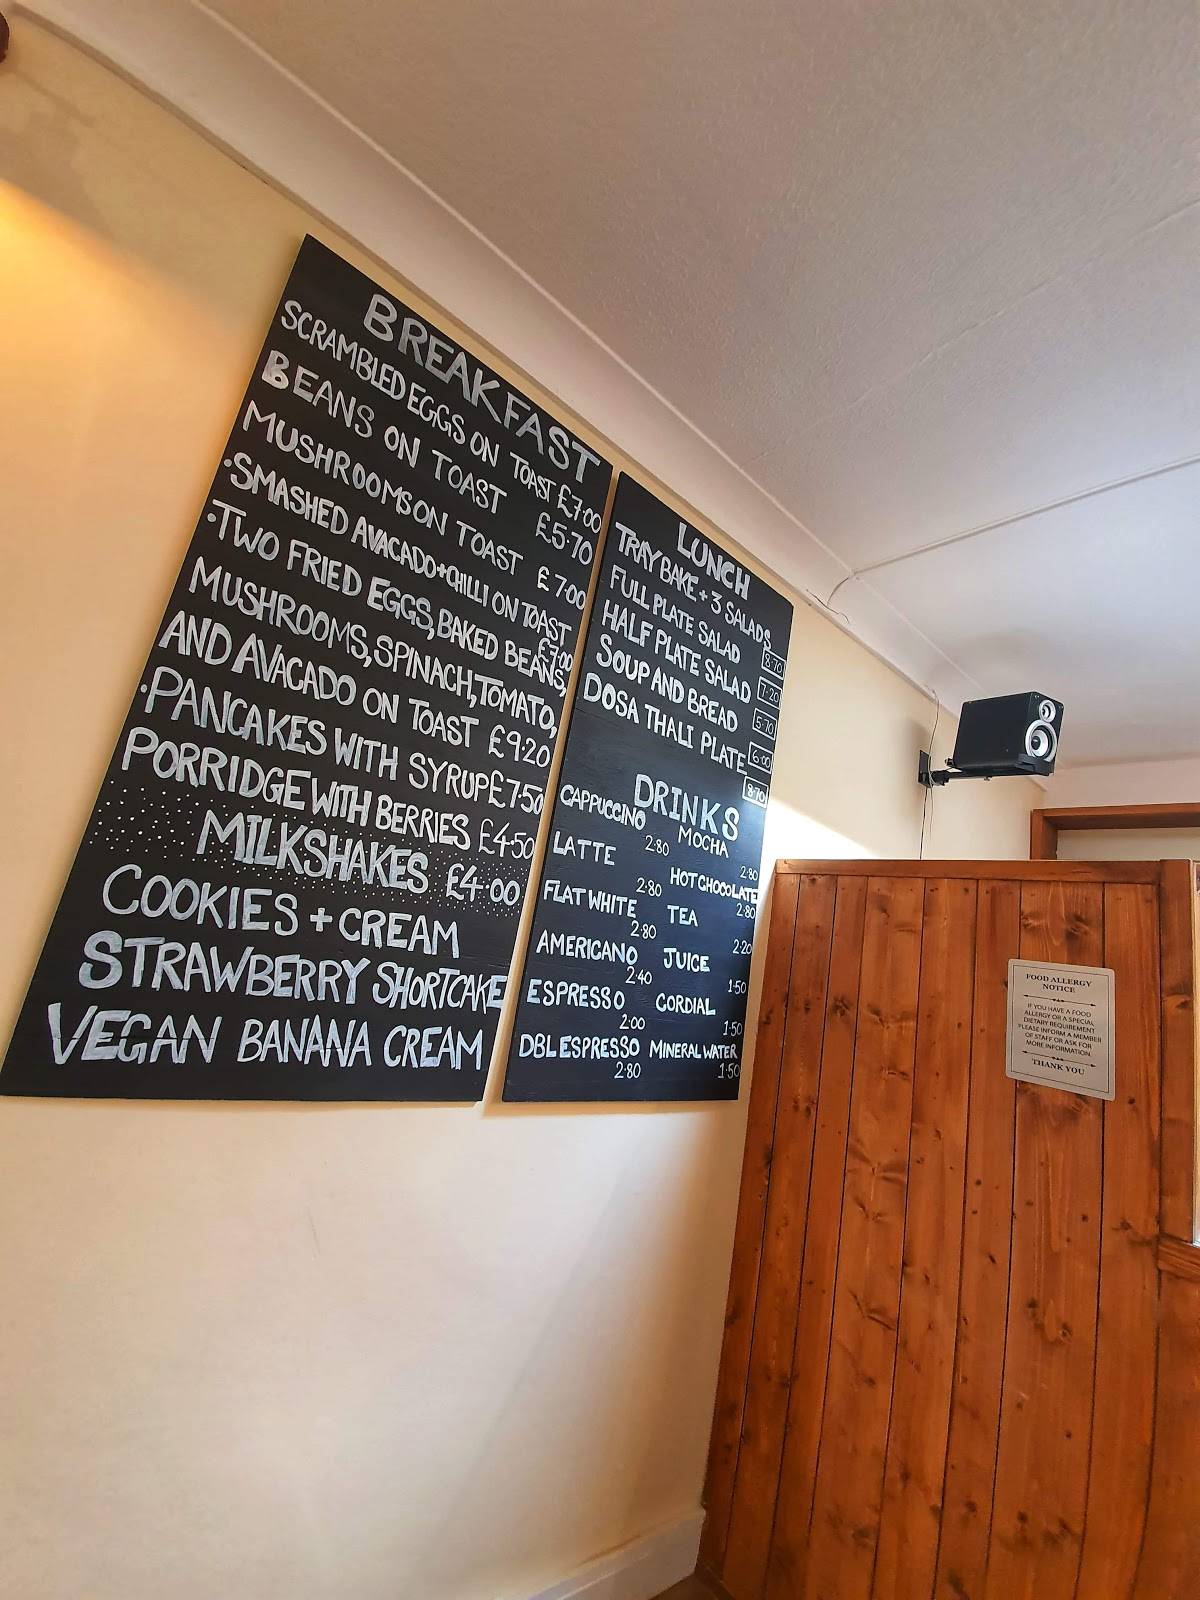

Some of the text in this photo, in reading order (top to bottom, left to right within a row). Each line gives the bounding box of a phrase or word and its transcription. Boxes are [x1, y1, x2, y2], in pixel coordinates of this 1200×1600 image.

[281, 300, 405, 400] SCRAMBLED
[408, 383, 465, 445] EGGS
[470, 432, 499, 467] ON
[510, 452, 556, 503] TOAST
[363, 294, 600, 482] BREAKFAST
[262, 350, 374, 438] BEANS
[384, 426, 420, 468] ON
[432, 449, 507, 514] TOAST
[242, 400, 412, 515] MUSHROOMS
[413, 505, 448, 536] ON
[456, 520, 523, 575] TOAST
[229, 452, 348, 534] SMASHED
[492, 590, 518, 623] ON
[522, 601, 572, 647] TOAST
[676, 522, 750, 600] LUNCH
[212, 499, 280, 561] TWO
[287, 539, 362, 597] FRIED
[437, 608, 498, 660] BAKED
[616, 522, 660, 572] TRAY
[659, 556, 699, 602] BAKE
[710, 591, 722, 614] 3
[724, 602, 771, 651] SALADS
[610, 564, 740, 664] FULL PLATE SALAD
[601, 600, 751, 703] HALF PLATE SALAD
[158, 610, 232, 665] AND
[231, 633, 356, 706] AVACADO
[362, 687, 400, 724] ON
[409, 698, 479, 748] TOAST
[596, 634, 738, 732] SOUP AND BREAD
[144, 666, 327, 756] PANCAKES
[334, 727, 399, 781] WITH
[408, 752, 490, 801] SYRUP
[583, 673, 747, 775] DOSA THALI PLATE
[122, 726, 312, 810] PORRIDGE
[311, 777, 372, 826] WITH
[376, 794, 470, 851] BERRIES
[560, 784, 646, 830] CAPPUCCINO
[634, 774, 739, 842] DRINKS
[196, 809, 429, 893] MILKSHAKES
[553, 830, 617, 866] LATTE
[678, 825, 729, 858] MOCHA
[544, 880, 637, 919] FLAT WHITE
[670, 866, 758, 904] HOT CHOCOLATE
[102, 864, 460, 959] COOKIES + CREAM
[667, 905, 698, 927] TEA
[536, 930, 638, 966] AMERICANO
[663, 948, 710, 973] JUICE
[79, 930, 508, 1014] STRAWBERRY SHORTCAKE
[526, 979, 625, 1010] ESPRESSO
[1026, 974, 1092, 987] FOOD ALLERGY
[1043, 984, 1075, 993] NOTICE
[655, 993, 716, 1016] CORDIAL
[1024, 1010, 1050, 1018] ALLERGY
[1068, 1017, 1094, 1026] SPECIAL
[1024, 1016, 1095, 1034] DIETARY REQUIREMENT
[1072, 1010, 1091, 1018] FOOD
[48, 1003, 483, 1070] VEGAN BANANA CREAM
[518, 1034, 640, 1060] DBL ESPRESSO
[650, 1040, 738, 1060] MINERAL WATER
[1018, 1024, 1040, 1032] PLEASE
[1040, 1027, 1065, 1036] INFORM
[1073, 1034, 1102, 1043] MEMBER
[1026, 1040, 1044, 1048] MORE
[1034, 1034, 1053, 1042] STAFF
[1032, 1058, 1084, 1074] THANK YOU
